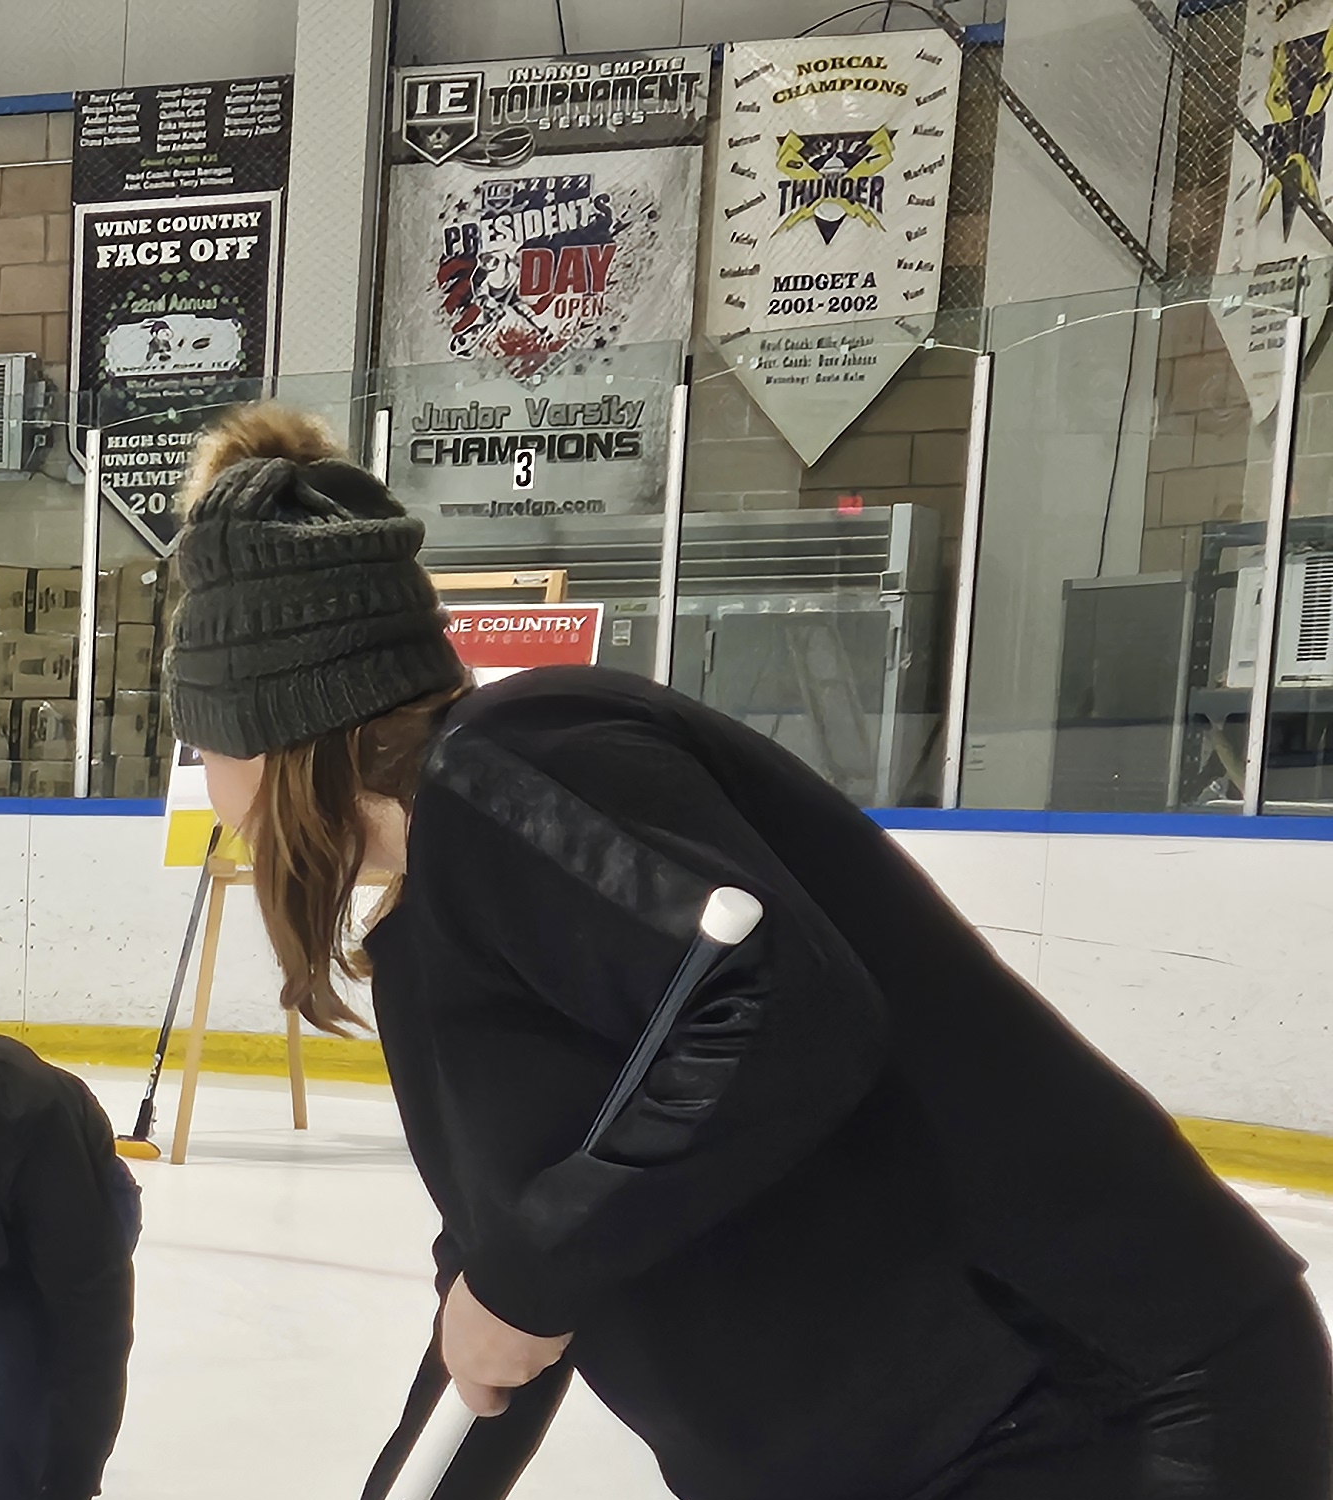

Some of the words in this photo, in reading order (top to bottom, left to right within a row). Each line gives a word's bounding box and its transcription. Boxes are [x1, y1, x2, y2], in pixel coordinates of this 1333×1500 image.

[509, 64, 590, 84] INLAND
[599, 56, 685, 76] EMPIRE
[796, 55, 889, 76] NORCAL
[414, 82, 471, 115] IE
[489, 73, 701, 124] TOURNAMENT
[772, 77, 909, 104] CHAMPIONS
[539, 112, 645, 131] SERIES
[777, 175, 886, 217] THUNDER
[94, 218, 152, 238] WINE
[157, 212, 262, 234] COUNTRY
[96, 240, 181, 269] FACE
[189, 235, 258, 262] OFF
[518, 243, 617, 297] DAY
[772, 272, 859, 293] MIDGET
[861, 271, 877, 289] A
[169, 293, 217, 312] Annual
[554, 295, 604, 320] OPEN
[768, 294, 879, 316] 2001-2002
[412, 400, 511, 433] Junior
[524, 394, 646, 429] Varsity
[107, 434, 154, 449] HIGH
[409, 430, 644, 467] CHAMPIONS
[101, 452, 164, 468] UNIOR
[516, 452, 532, 487] 3
[478, 616, 588, 632] COUNTRY
